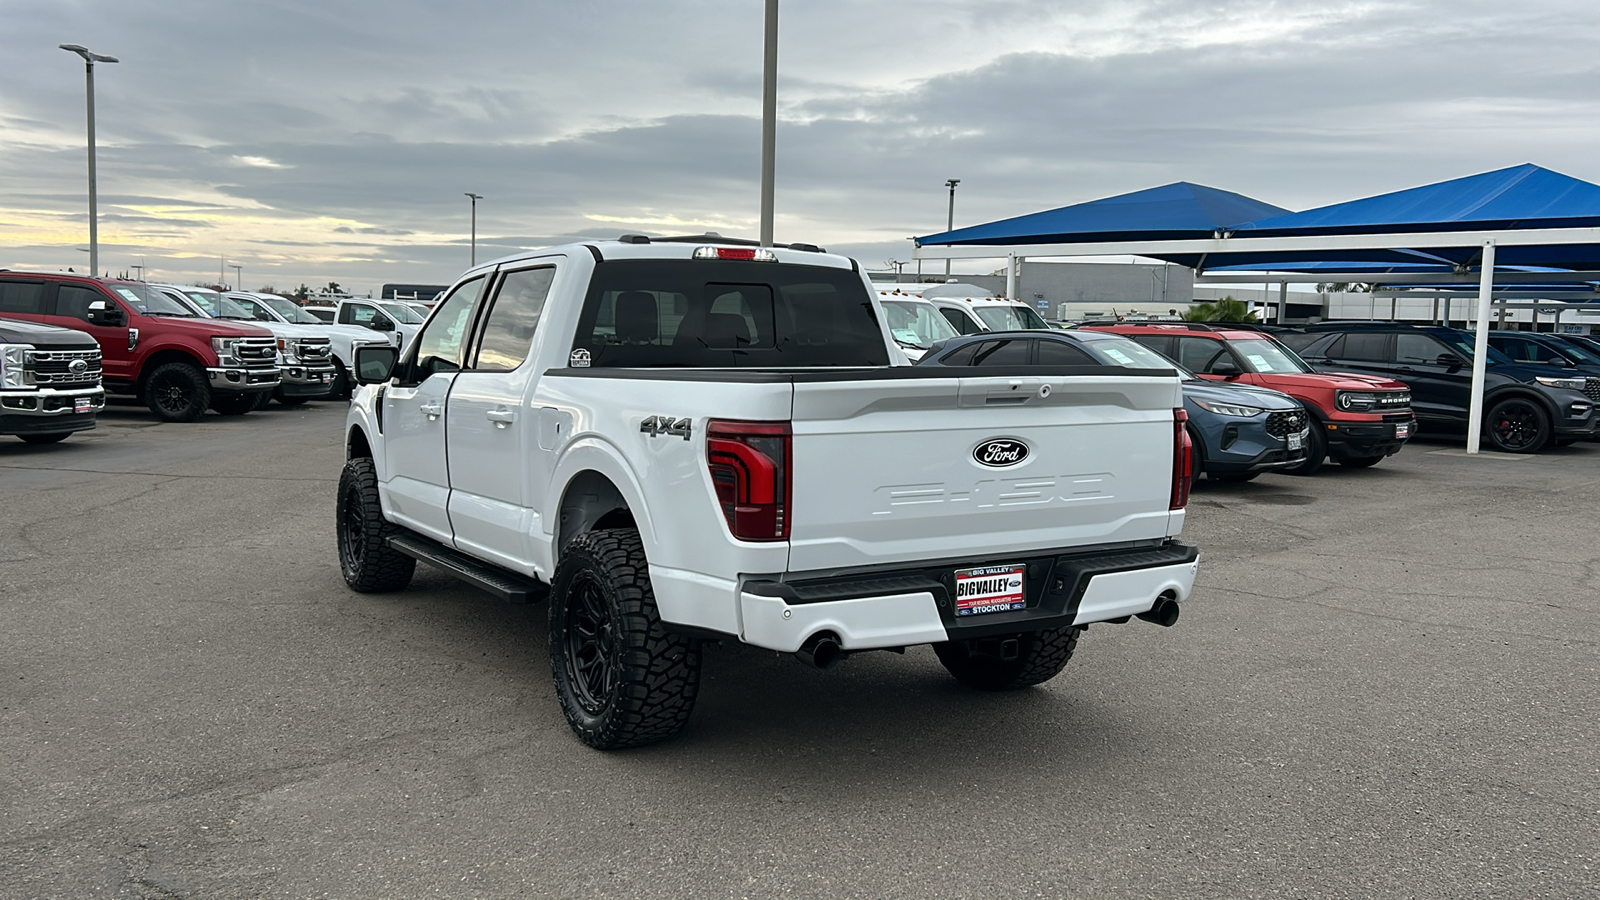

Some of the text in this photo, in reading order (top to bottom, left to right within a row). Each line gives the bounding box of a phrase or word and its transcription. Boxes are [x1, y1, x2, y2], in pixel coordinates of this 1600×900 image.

[983, 443, 1020, 463] Ford
[958, 578, 1009, 596] BIGVALLEY
[973, 604, 1010, 614] STOCKTON
